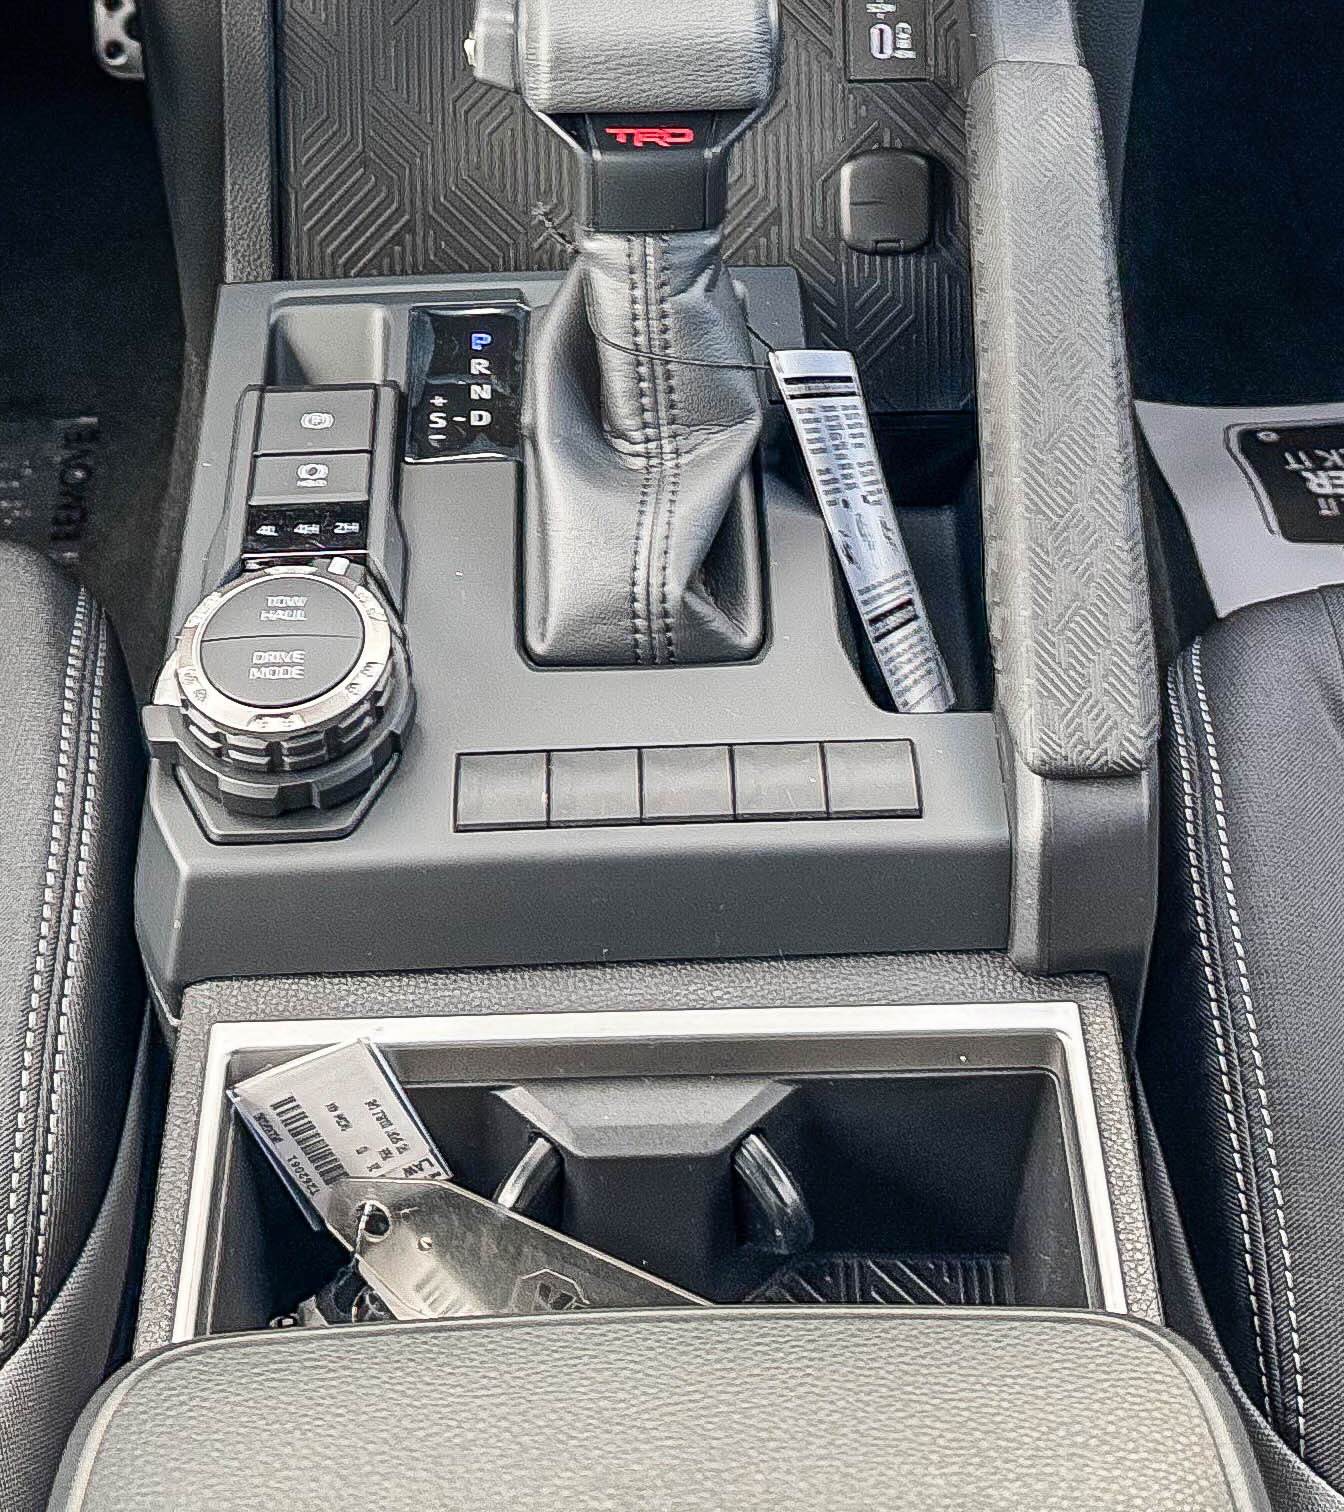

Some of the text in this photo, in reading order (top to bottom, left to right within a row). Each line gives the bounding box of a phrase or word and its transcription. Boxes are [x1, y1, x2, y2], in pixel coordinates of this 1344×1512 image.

[605, 127, 694, 147] TRD
[471, 332, 492, 351] P
[470, 358, 493, 376] R
[470, 384, 492, 400] N
[428, 410, 492, 428] S D
[1284, 450, 1313, 470] IT
[1318, 497, 1340, 517] IT
[267, 596, 308, 608] TOW
[260, 610, 308, 622] HAUL
[253, 651, 305, 664] DRIVE
[249, 666, 305, 680] MODE
